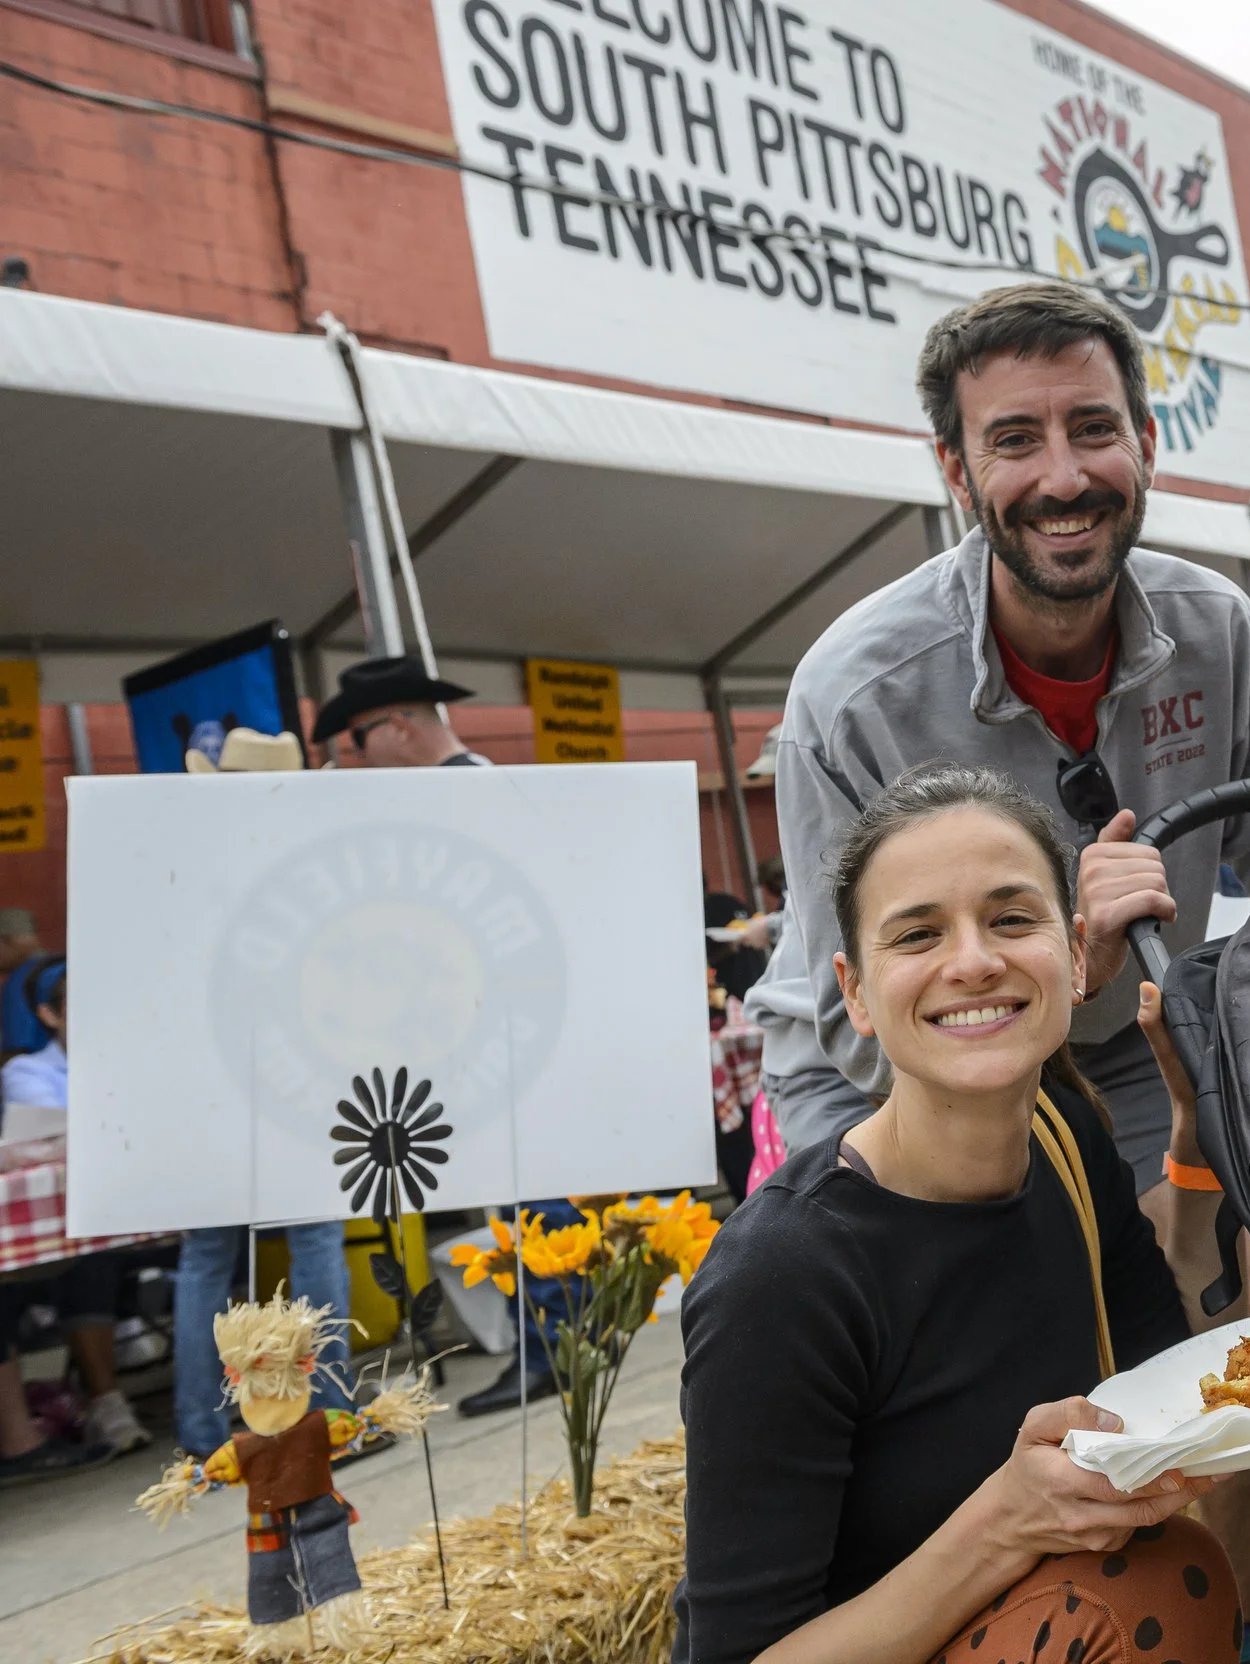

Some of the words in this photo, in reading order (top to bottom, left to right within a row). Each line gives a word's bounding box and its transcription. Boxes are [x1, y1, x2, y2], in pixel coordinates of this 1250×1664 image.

[464, 0, 729, 175] SOUTH
[746, 95, 1035, 273] PITTSBURG
[830, 30, 904, 135] TO
[1037, 95, 1165, 210] NATIONAL
[480, 125, 898, 325] TENNESSEE
[1141, 690, 1205, 747] BXC
[1144, 752, 1173, 776] STATE
[1176, 743, 1206, 762] 2022
